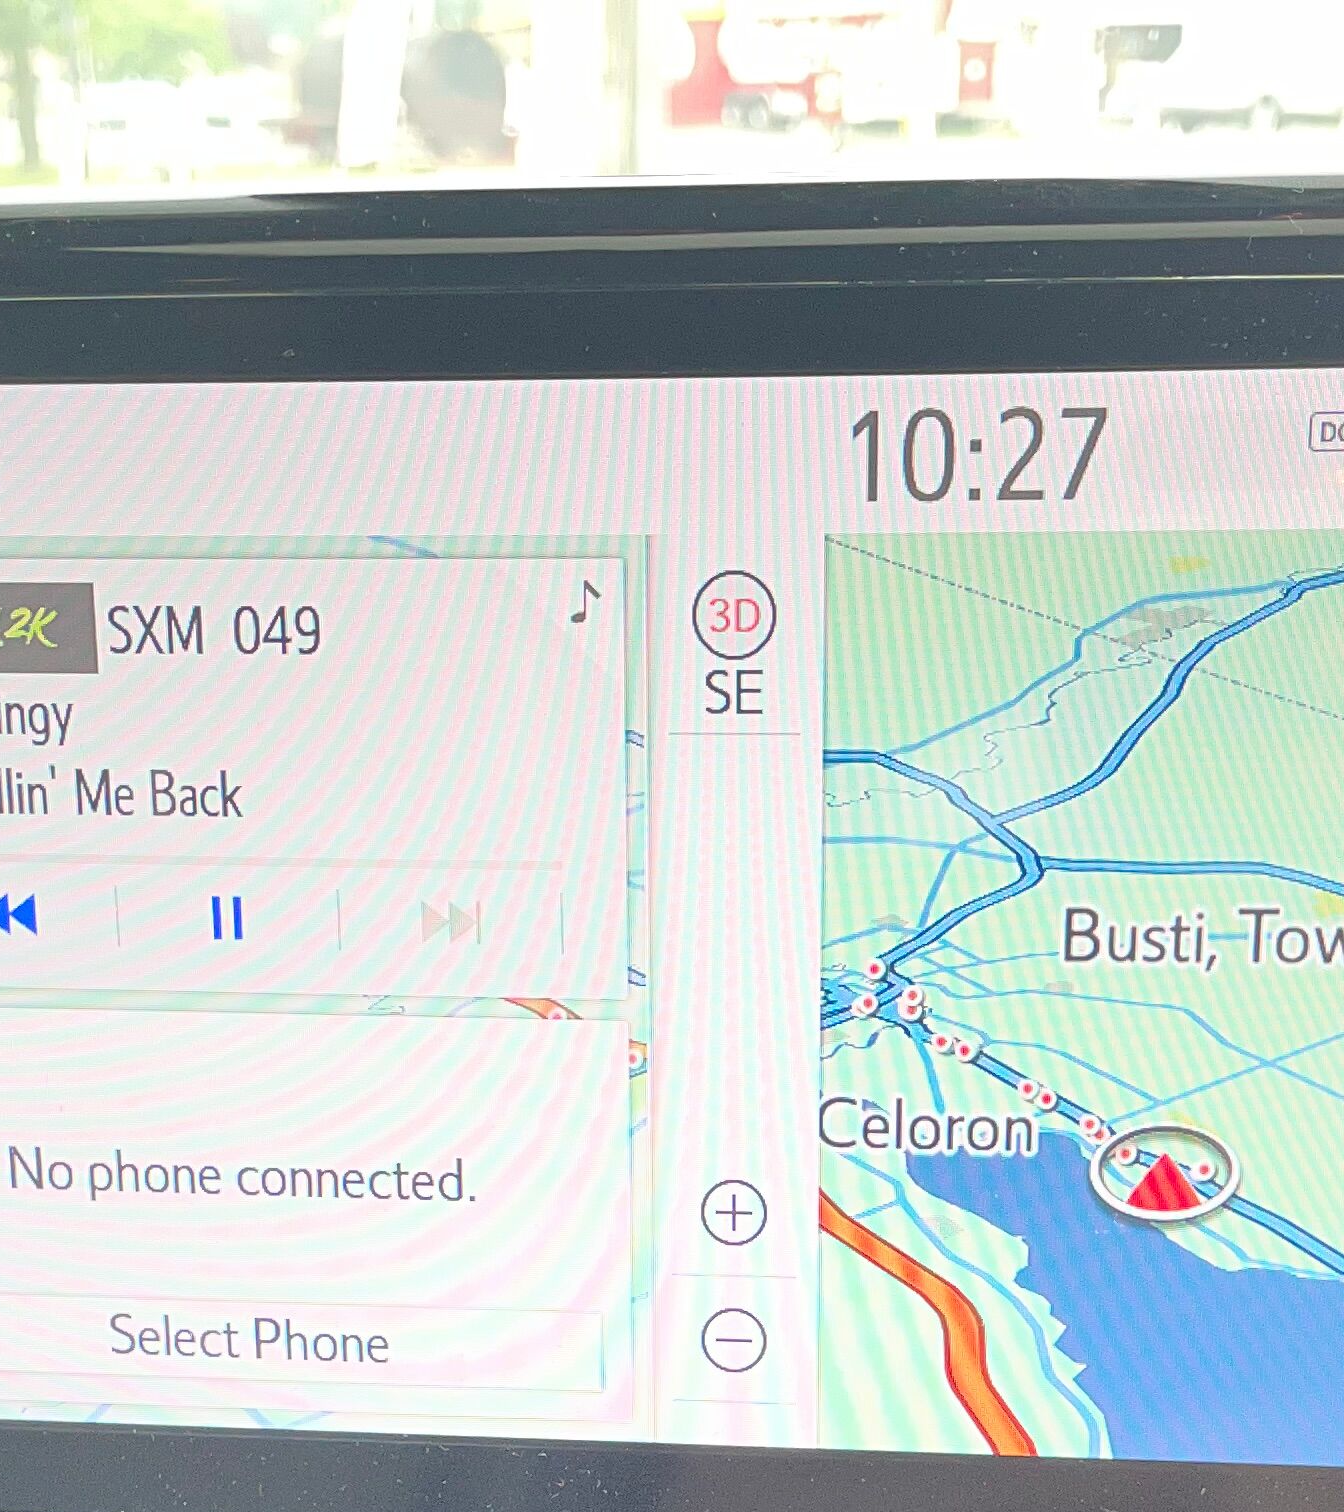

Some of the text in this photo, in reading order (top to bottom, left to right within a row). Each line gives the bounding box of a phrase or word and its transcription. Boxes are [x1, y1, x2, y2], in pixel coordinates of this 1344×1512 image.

[852, 406, 1109, 502] 10:27
[107, 605, 321, 655] SXM 049
[709, 598, 761, 634] 3D
[705, 669, 764, 715] SE
[74, 769, 135, 817] Me
[150, 770, 244, 818] Back
[1063, 907, 1218, 972] Busti,
[819, 1097, 1034, 1153] Celoron
[8, 1146, 476, 1202] No phone connected.
[109, 1313, 390, 1364] Select Phone
